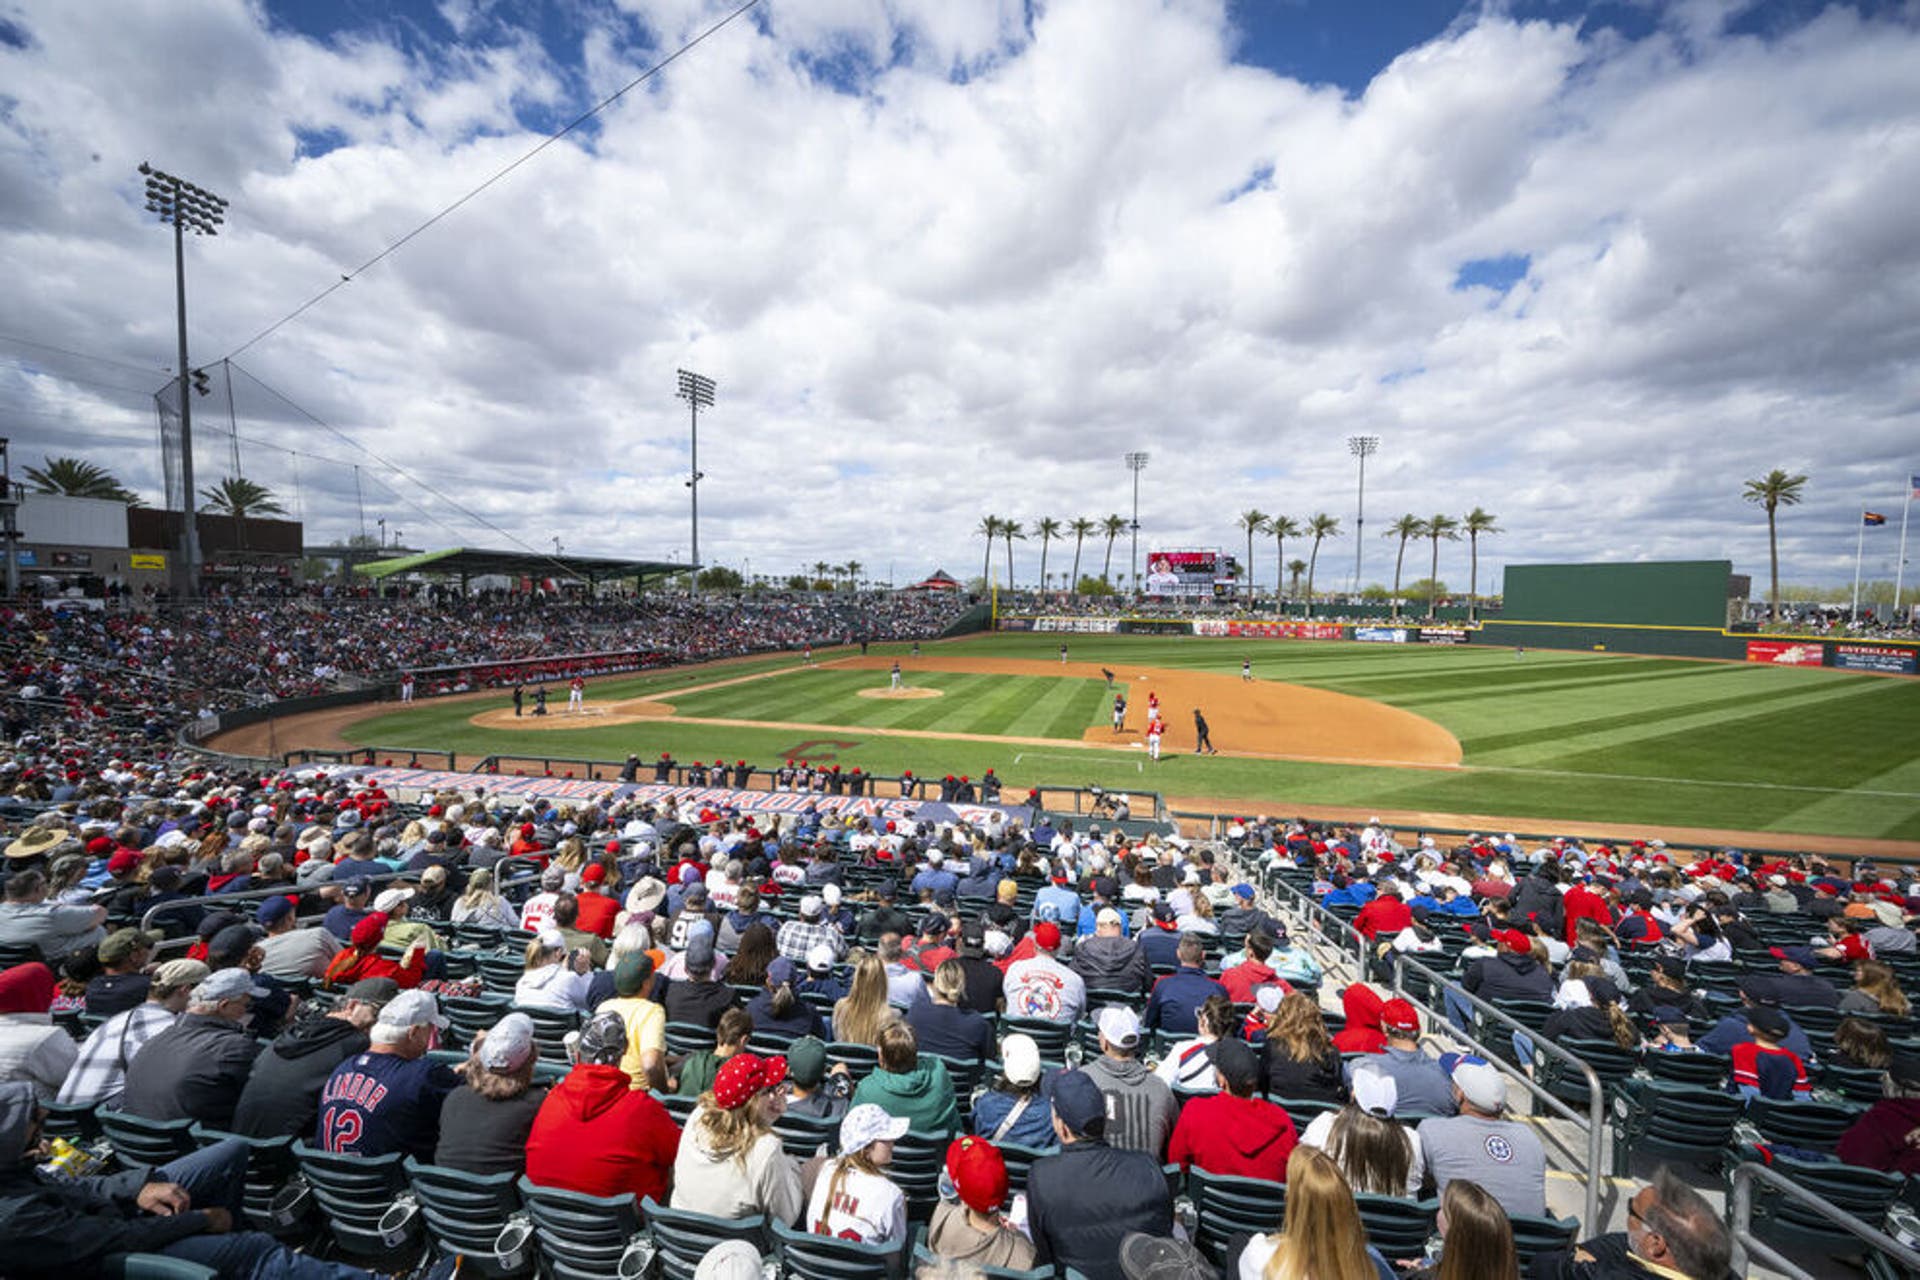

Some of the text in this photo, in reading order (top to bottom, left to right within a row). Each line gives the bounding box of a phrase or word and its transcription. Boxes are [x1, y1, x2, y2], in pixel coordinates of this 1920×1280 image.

[524, 915, 541, 933] 5
[323, 1072, 388, 1113] LINDOR
[324, 1106, 363, 1157] 12
